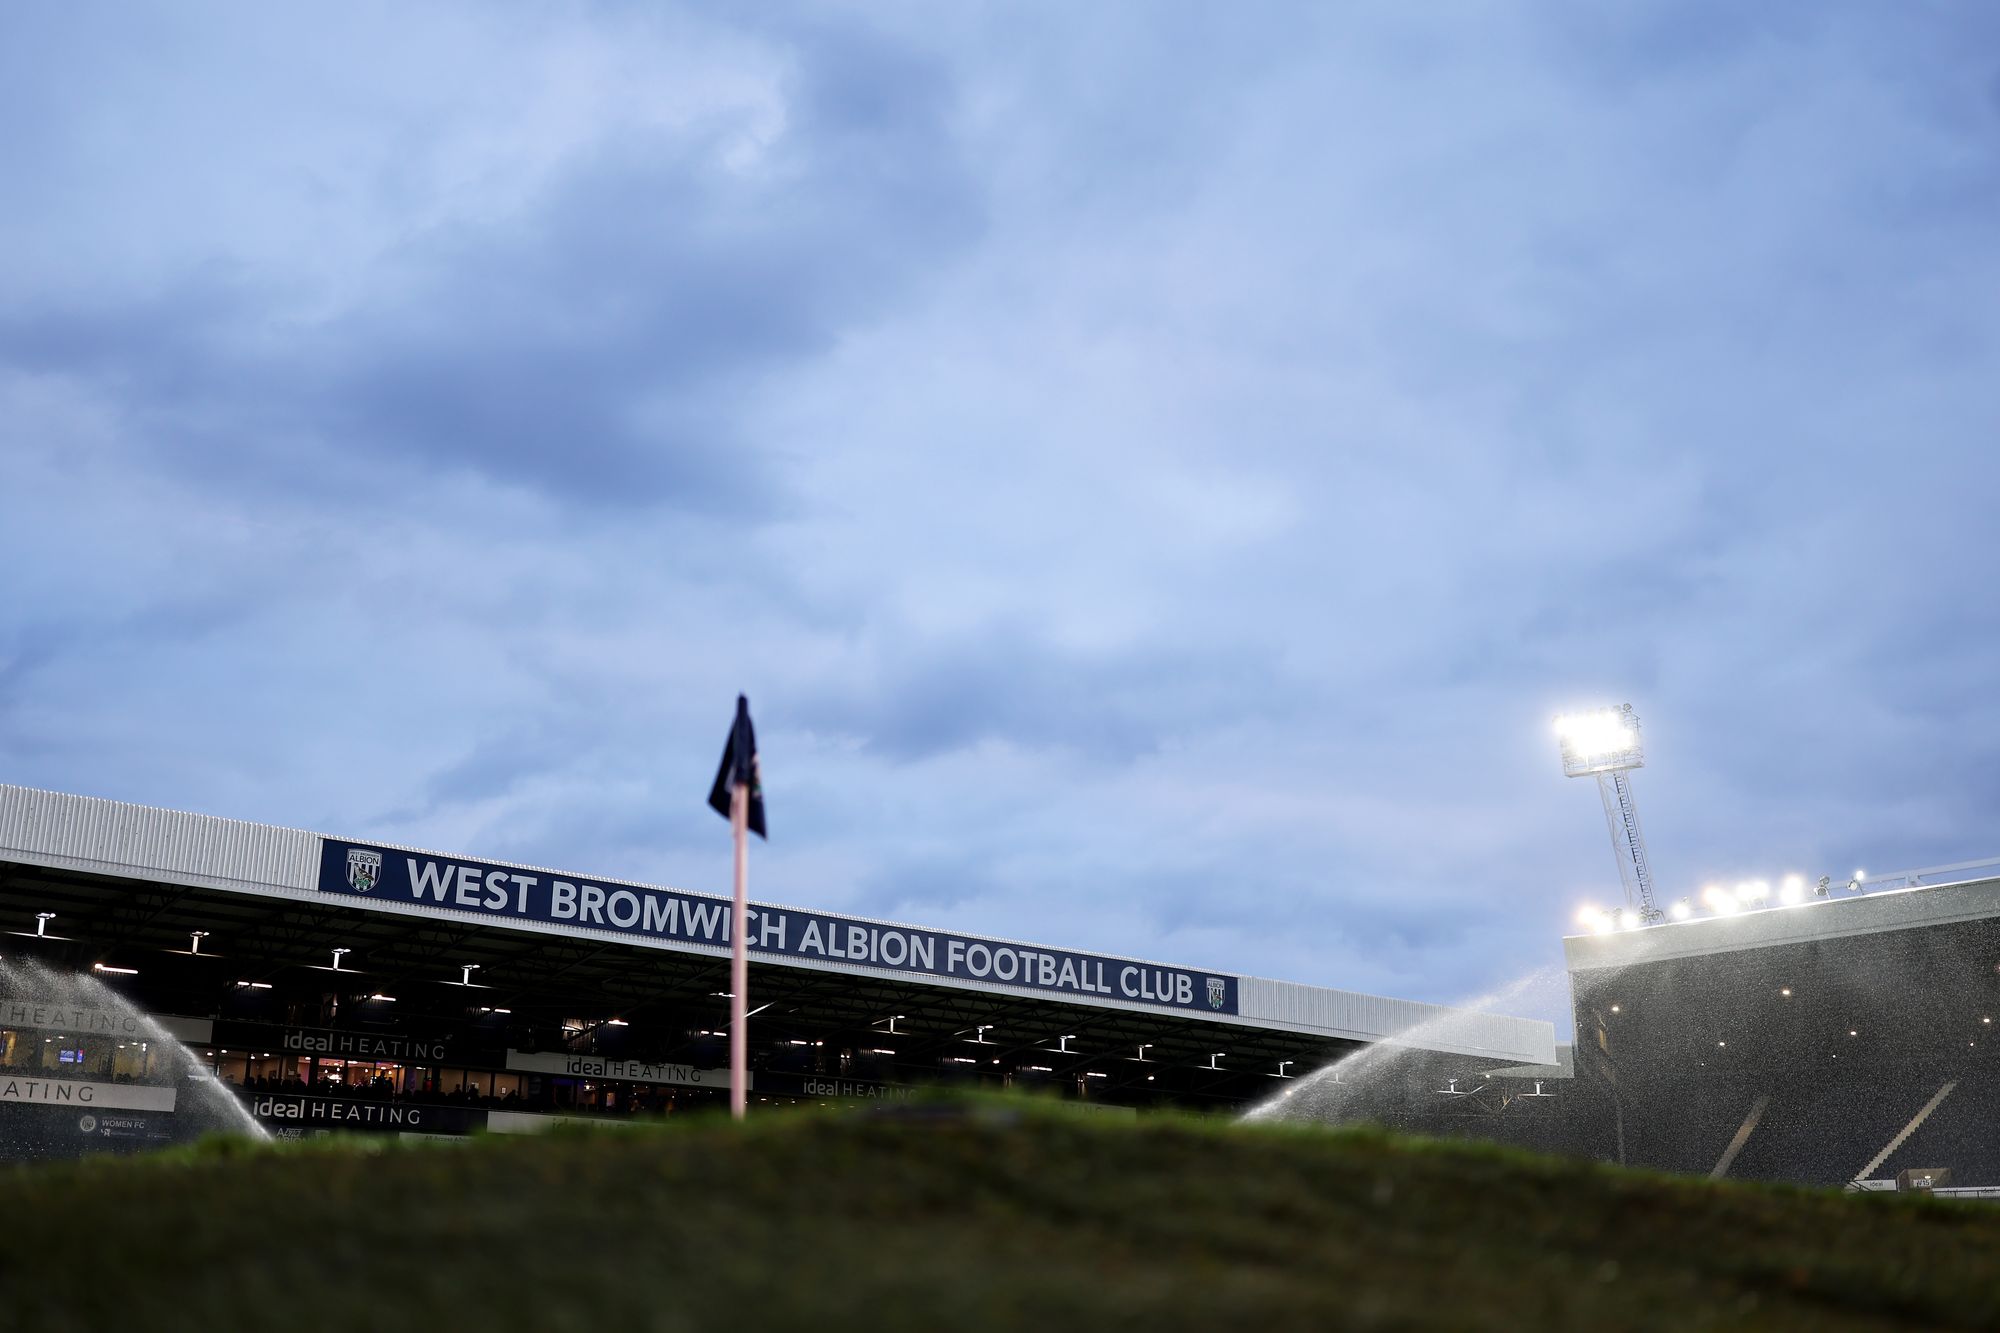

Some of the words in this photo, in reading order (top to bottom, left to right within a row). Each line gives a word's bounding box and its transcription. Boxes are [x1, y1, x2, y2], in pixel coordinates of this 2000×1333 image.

[349, 854, 379, 865] ALBION
[406, 858, 538, 913] WEST
[551, 880, 787, 949] BROMWICH
[798, 920, 935, 970] ALBION
[947, 940, 1112, 993] FOOTBALL
[1120, 966, 1194, 1004] CLUB
[10, 1006, 136, 1032] HEATING
[284, 1029, 333, 1052] ideal
[340, 1036, 445, 1060] HEATING
[566, 1056, 607, 1076] ideal
[613, 1064, 701, 1082] HEATING
[3, 1081, 94, 1102] ATING
[803, 1078, 838, 1096] ideal
[254, 1096, 304, 1119] ideal
[311, 1102, 420, 1125] HEATING
[102, 1119, 132, 1128] WOMEN
[134, 1121, 145, 1129] FC
